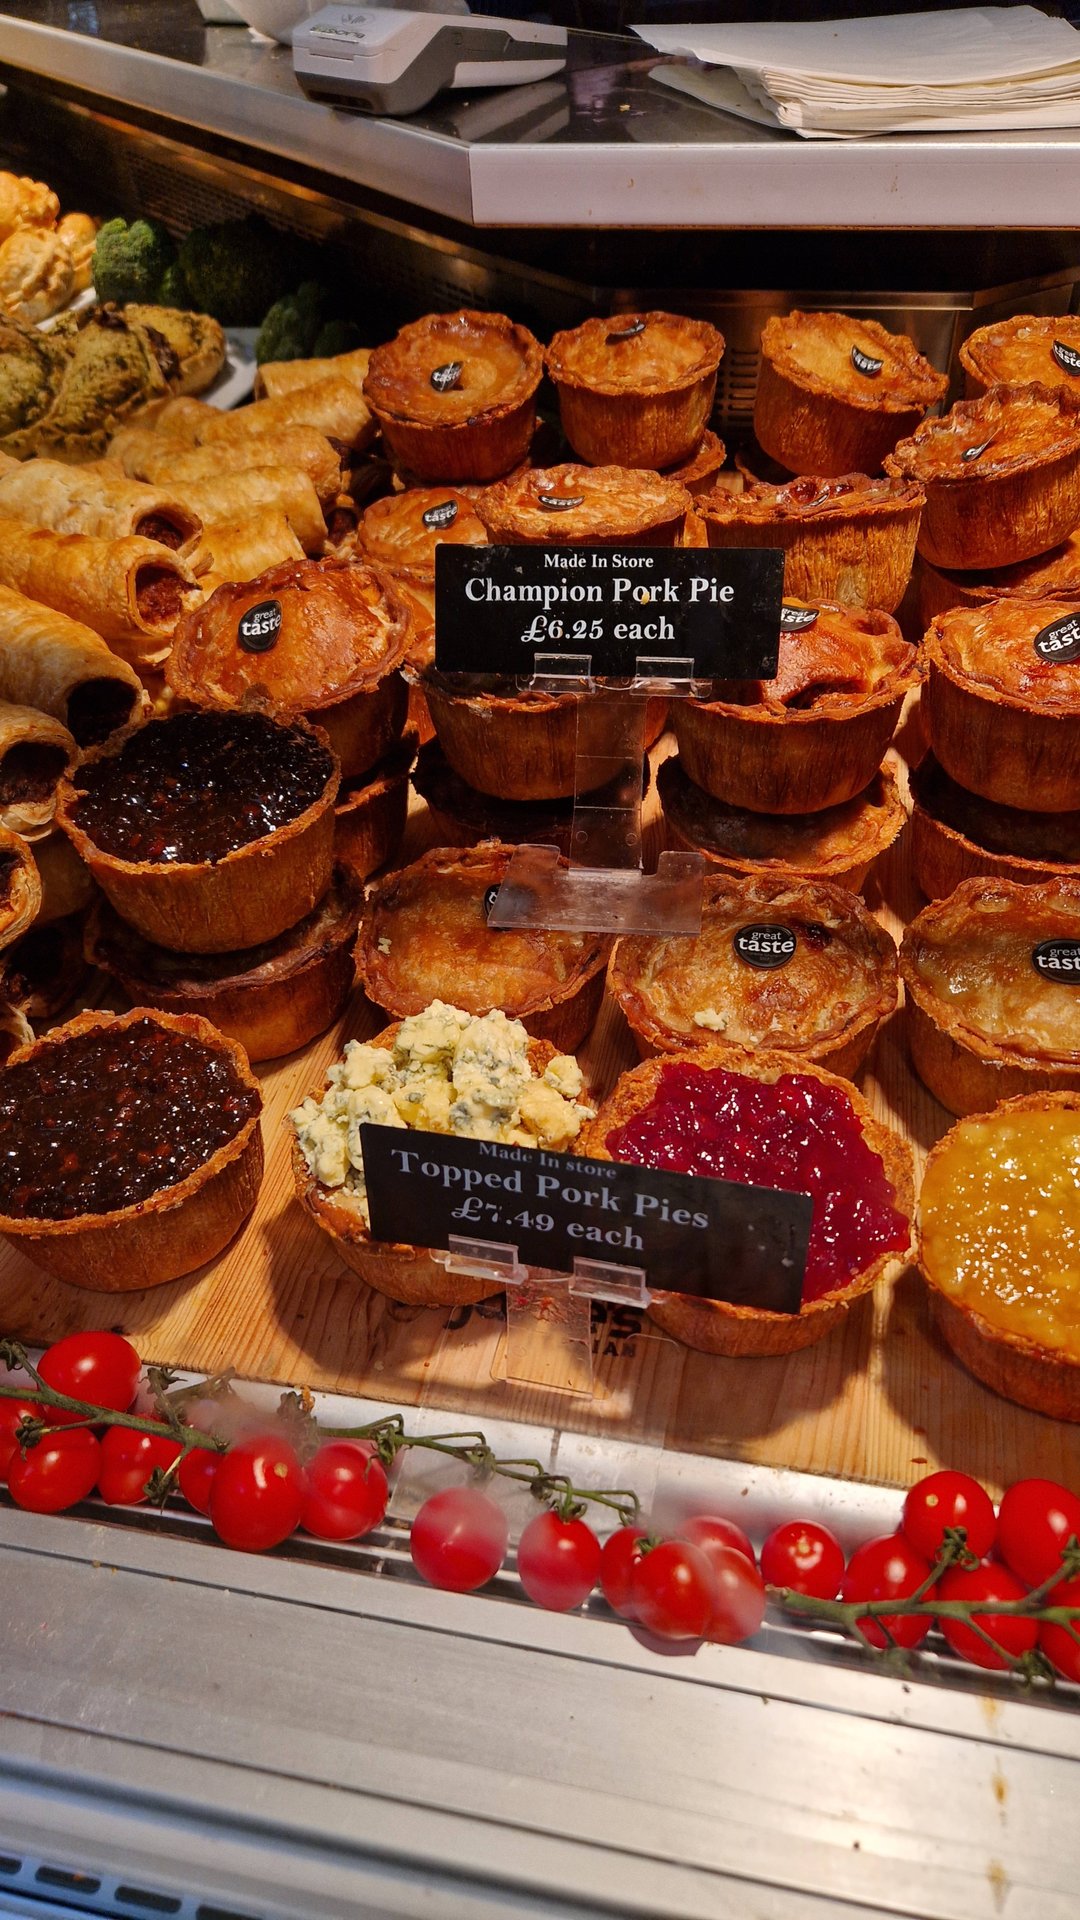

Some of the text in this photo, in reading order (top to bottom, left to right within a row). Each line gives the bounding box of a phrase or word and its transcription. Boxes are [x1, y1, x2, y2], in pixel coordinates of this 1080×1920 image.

[544, 554, 654, 568] Made In Store
[465, 578, 735, 610] Champion Pork Pie
[242, 615, 281, 636] taste
[254, 608, 276, 624] great
[521, 615, 675, 642] £6.25 each
[1049, 619, 1078, 641] great
[1038, 627, 1080, 653] tast
[738, 937, 795, 954] taste
[751, 932, 781, 941] great
[1036, 955, 1080, 970] tast
[479, 1142, 617, 1180] Made In store
[391, 1149, 709, 1229] Topped Pork Pies
[451, 1196, 644, 1251] £7.49 each
